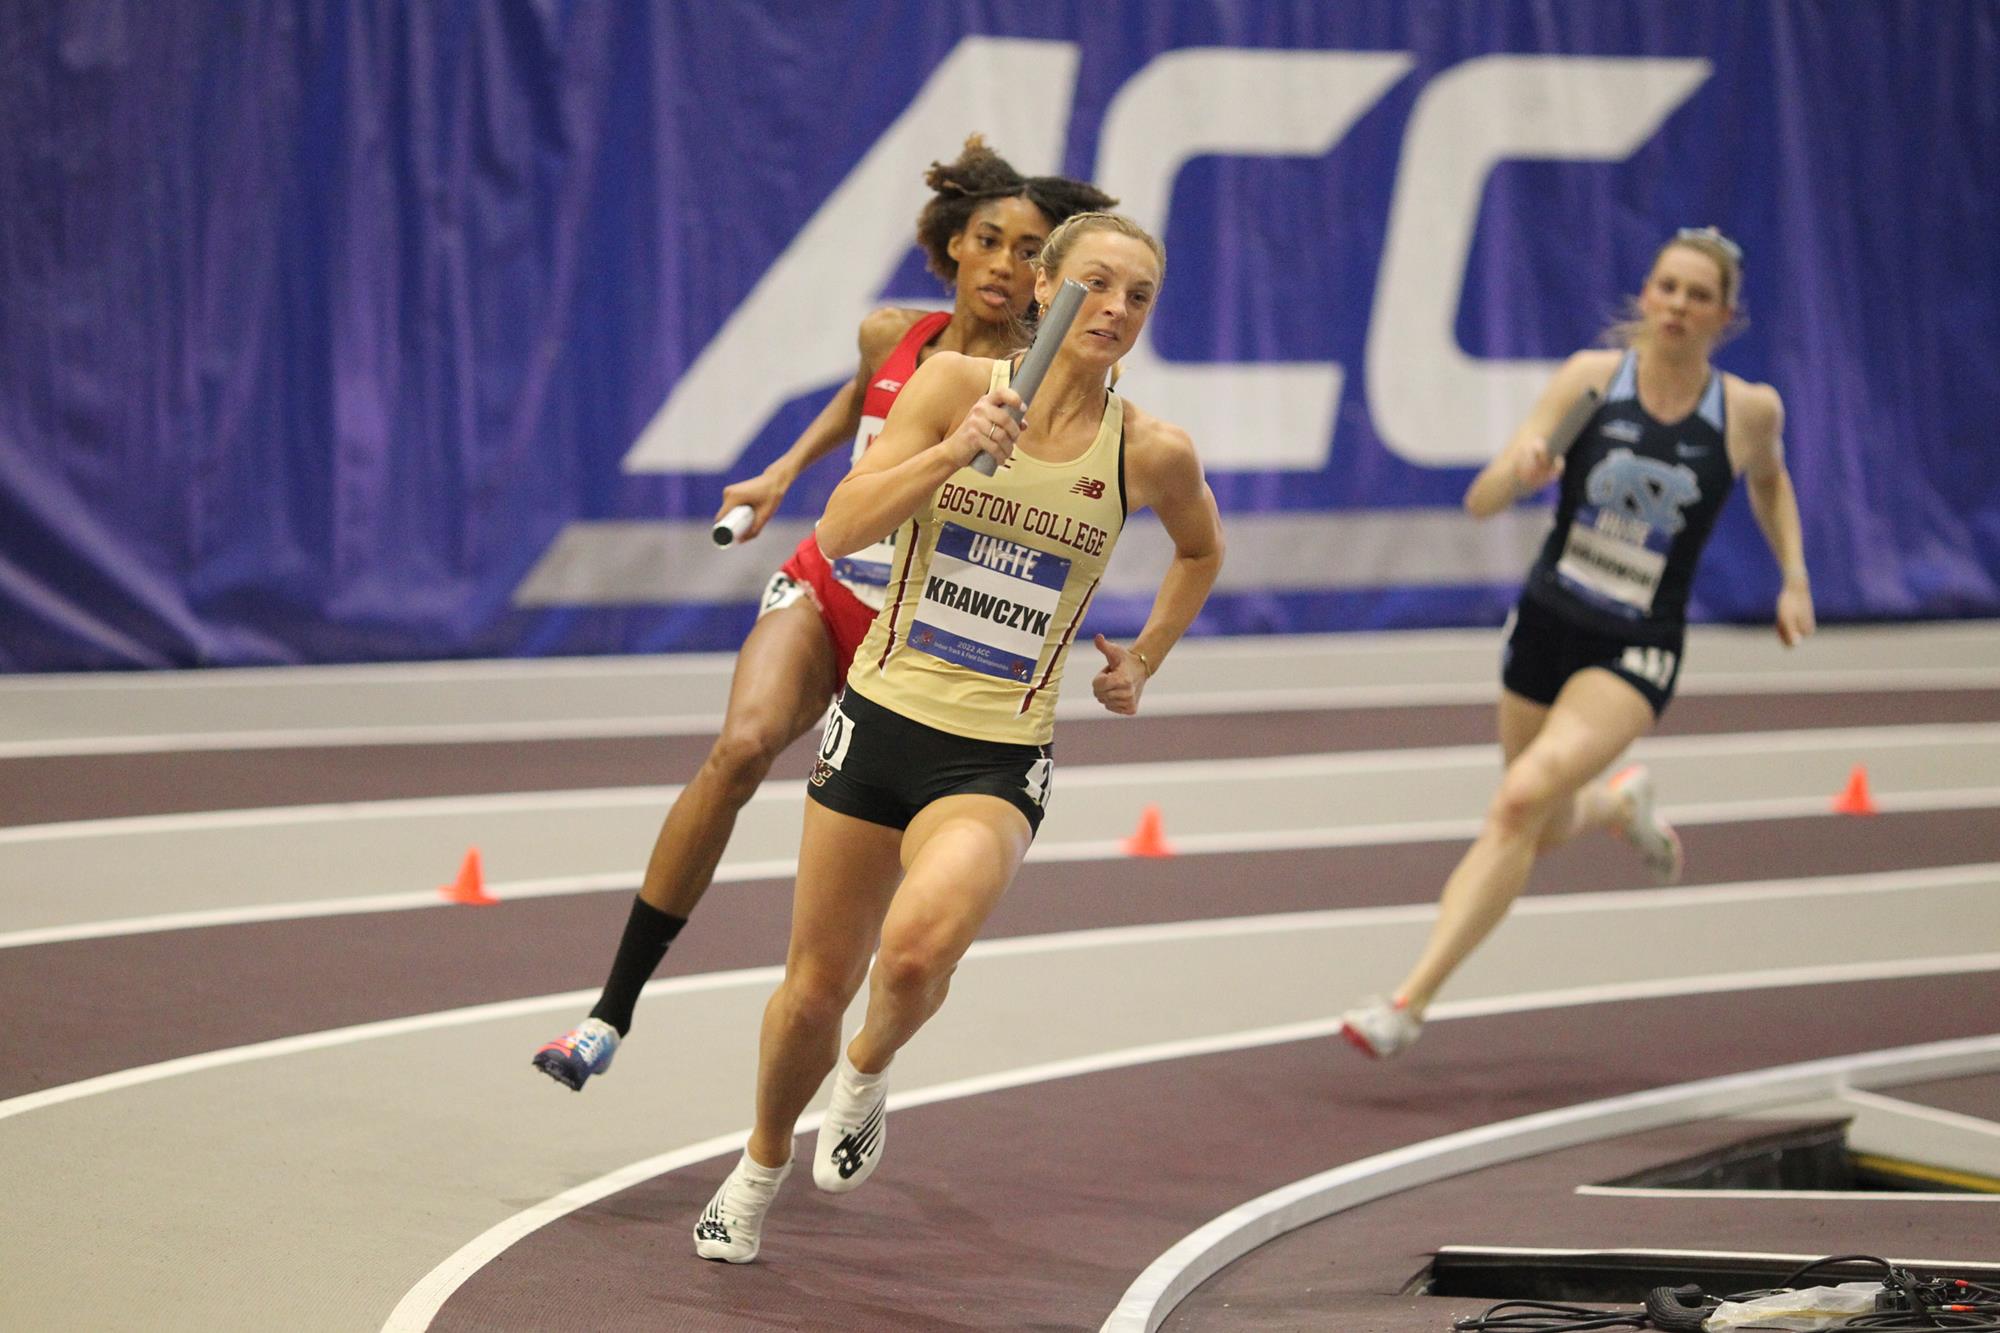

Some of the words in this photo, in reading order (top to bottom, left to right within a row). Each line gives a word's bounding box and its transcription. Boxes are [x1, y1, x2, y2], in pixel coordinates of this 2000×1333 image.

[622, 36, 1712, 474] ACC
[938, 483, 1021, 527] BOSTON
[1022, 507, 1108, 557] COLLEGE
[967, 533, 1042, 581] UNITE
[924, 575, 1052, 637] KRAWCZYK
[957, 641, 975, 653] 2022
[976, 648, 991, 657] ACC
